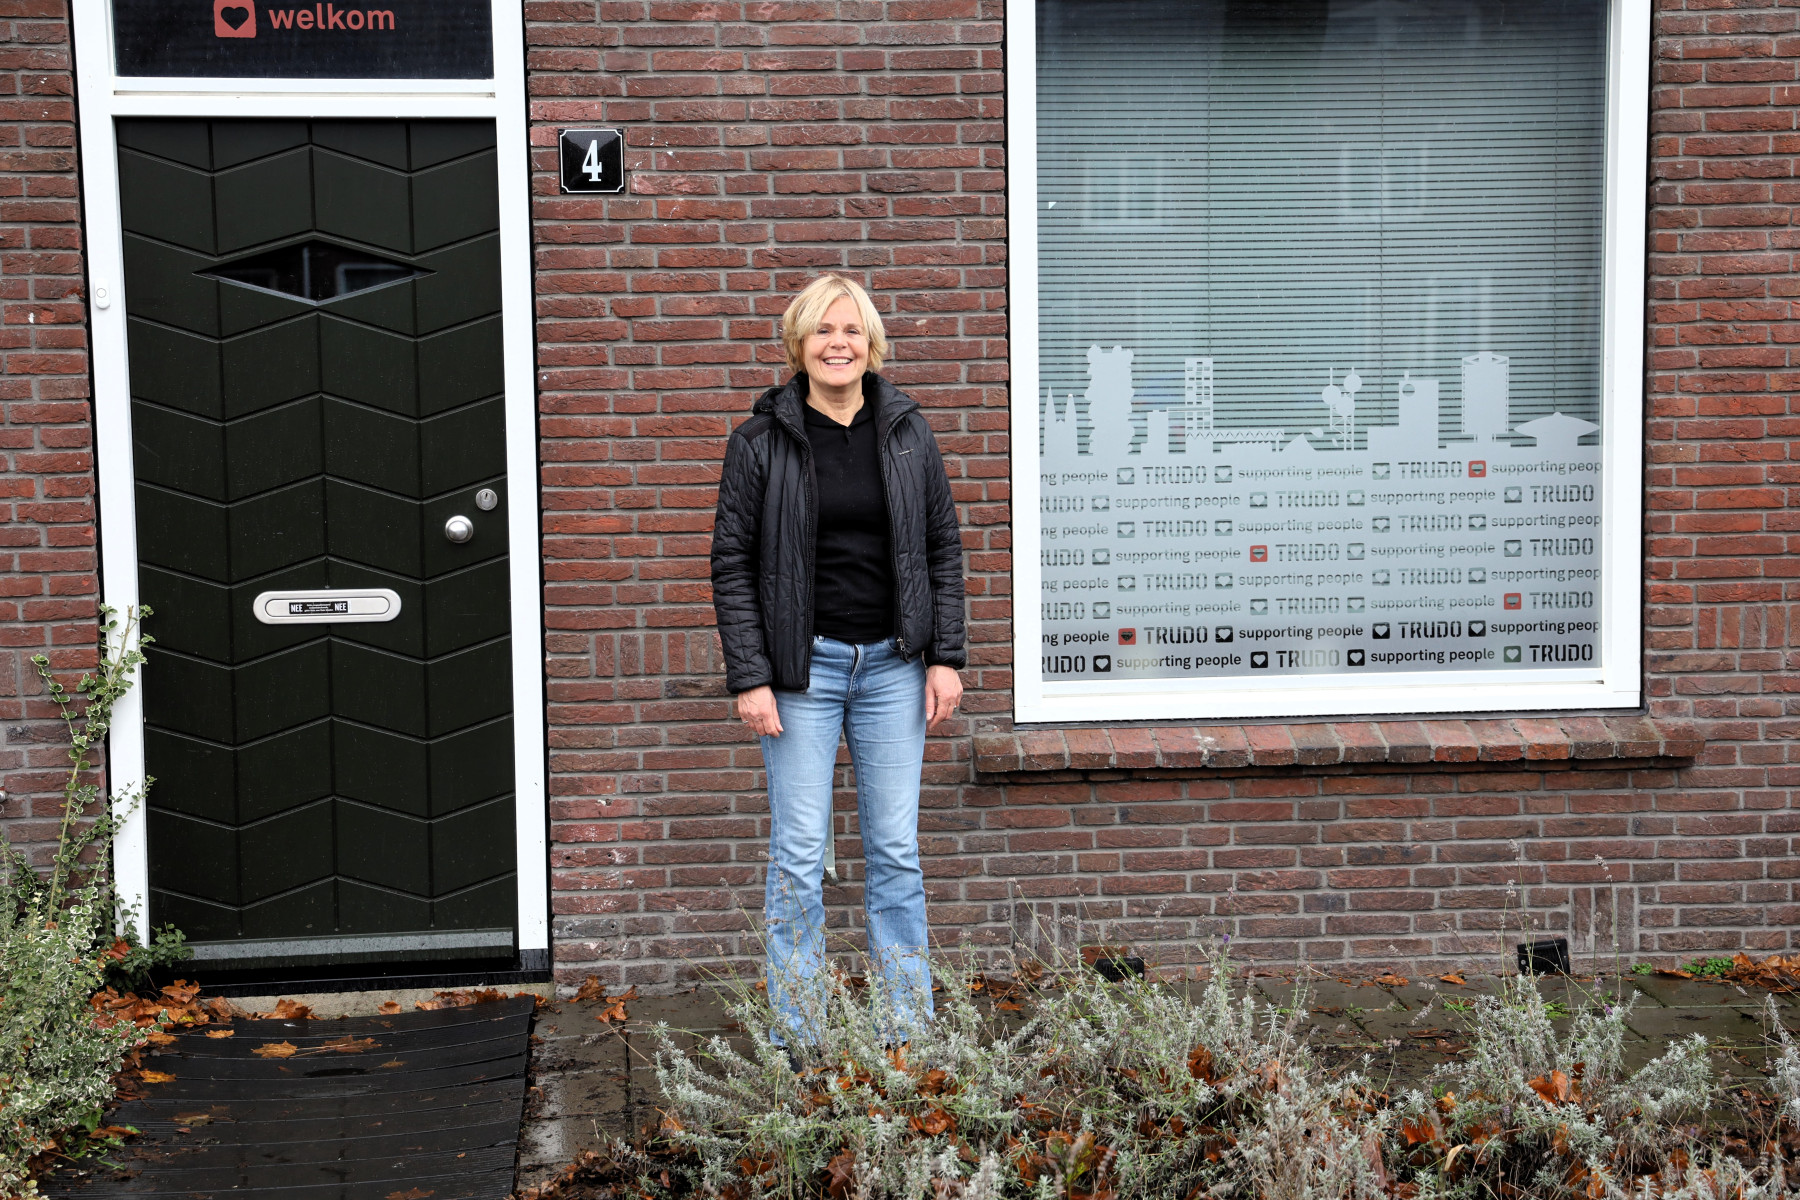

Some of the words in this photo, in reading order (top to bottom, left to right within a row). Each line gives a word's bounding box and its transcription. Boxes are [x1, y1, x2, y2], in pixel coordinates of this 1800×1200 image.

[268, 3, 395, 30] welkom
[582, 140, 602, 182] 4
[1062, 470, 1108, 484] people
[1143, 466, 1207, 484] TRUDO
[1238, 466, 1312, 481] supporting
[1317, 465, 1363, 480] people
[1398, 461, 1462, 479] TRUDO
[1492, 461, 1566, 475] supporting
[1116, 496, 1190, 509] supporting
[1195, 494, 1240, 507] people
[1275, 490, 1339, 507] TRUDO
[1371, 491, 1445, 504] supporting
[1450, 489, 1495, 503] people
[1530, 485, 1593, 503] TRUDO
[1063, 524, 1108, 536] people
[1143, 520, 1207, 537] TRUDO
[1238, 520, 1312, 534] supporting
[1318, 519, 1363, 532] people
[1398, 514, 1462, 532] TRUDO
[1492, 514, 1566, 529] supporting
[1116, 549, 1190, 563] supporting
[1195, 548, 1240, 562] people
[1275, 544, 1339, 562] TRUDO
[1371, 544, 1444, 558] supporting
[1450, 542, 1495, 556] people
[1530, 538, 1593, 556] TRUDO
[1063, 578, 1109, 591] people
[1144, 573, 1208, 591] TRUDO
[1239, 573, 1313, 587] supporting
[1317, 572, 1363, 586] people
[1398, 568, 1462, 585] TRUDO
[1491, 568, 1565, 582] supporting
[291, 604, 303, 612] NEE
[335, 603, 347, 611] NEE
[1117, 602, 1190, 616] supporting
[1195, 601, 1240, 615] people
[1276, 597, 1339, 614] TRUDO
[1371, 597, 1444, 610] supporting
[1450, 596, 1495, 609] people
[1529, 591, 1593, 609] TRUDO
[1064, 631, 1109, 645] people
[1144, 626, 1208, 644] TRUDO
[1239, 626, 1313, 641] supporting
[1318, 624, 1363, 639] people
[1398, 621, 1461, 638] TRUDO
[1491, 620, 1565, 634] supporting
[1117, 655, 1190, 670] supporting
[1196, 653, 1241, 668] people
[1276, 650, 1339, 668] TRUDO
[1371, 650, 1444, 664] supporting
[1450, 648, 1495, 662] people
[1529, 644, 1592, 662] TRUDO
